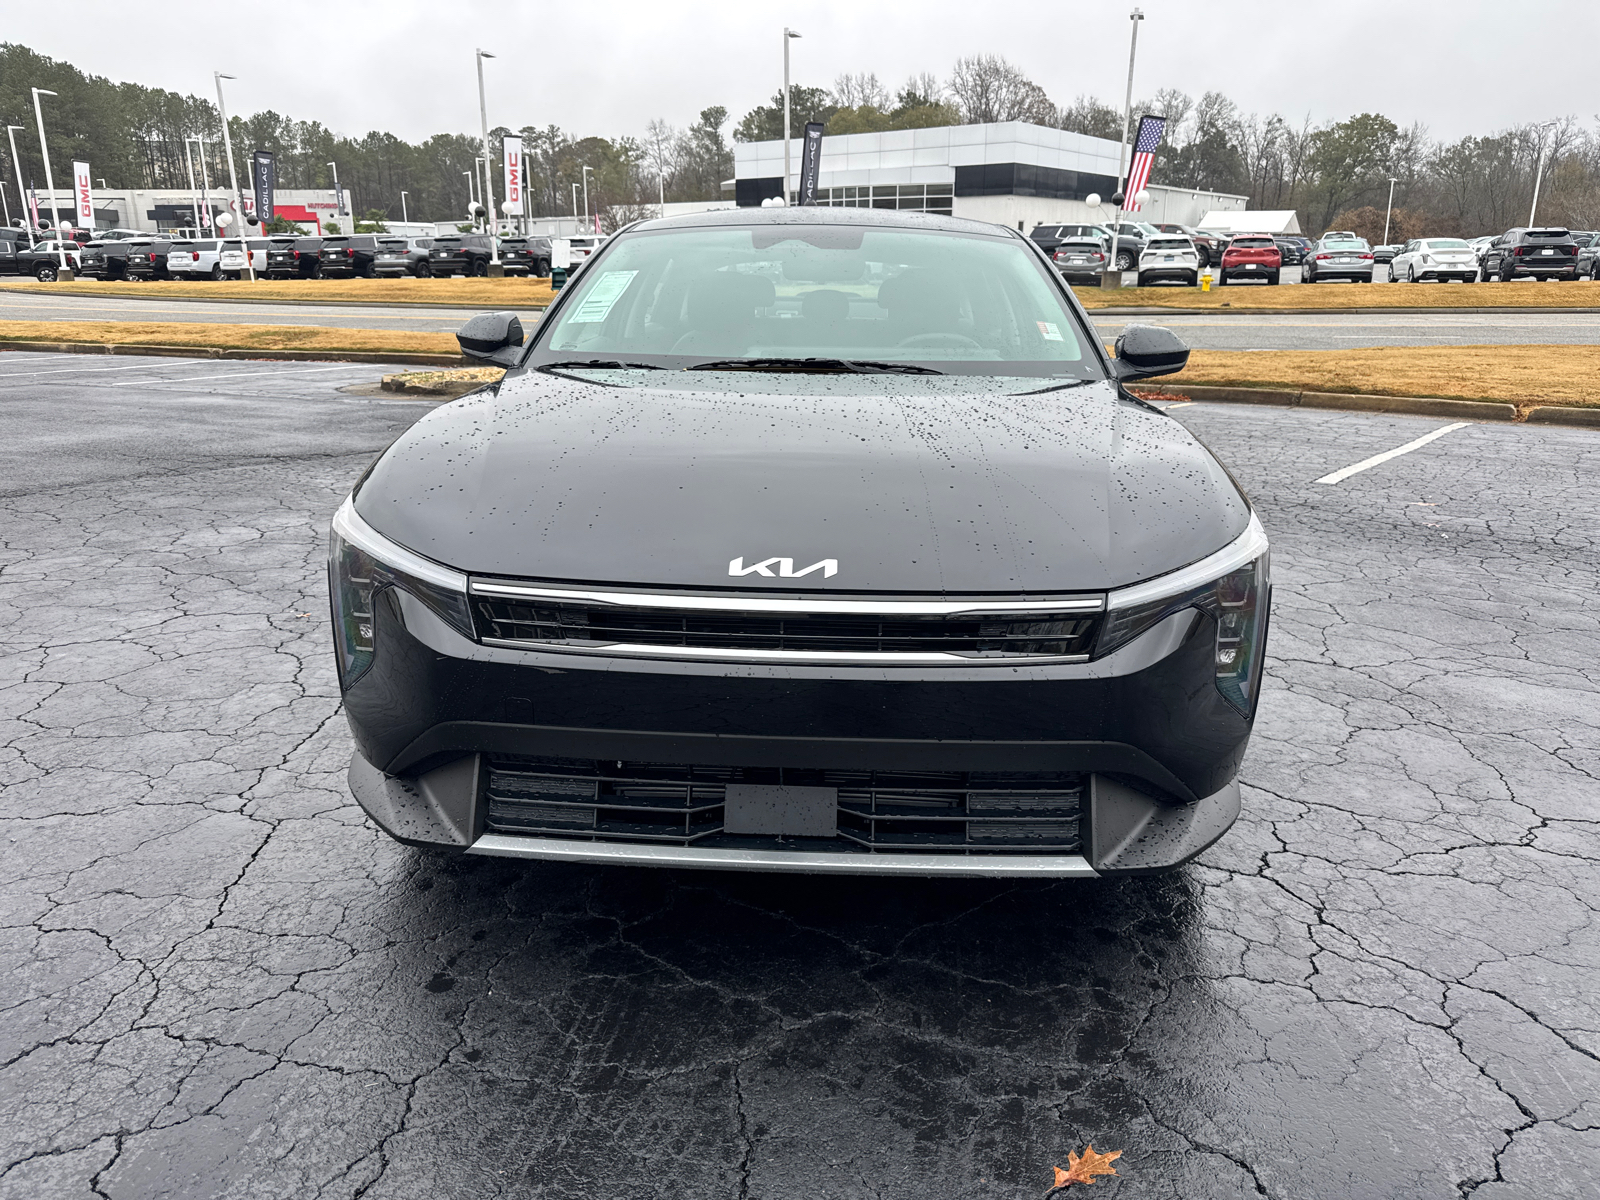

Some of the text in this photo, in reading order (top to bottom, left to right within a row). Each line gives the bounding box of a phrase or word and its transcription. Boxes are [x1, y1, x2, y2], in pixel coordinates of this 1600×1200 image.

[78, 174, 91, 217] GMC
[261, 167, 271, 219] CADILLAC
[508, 152, 519, 202] GMC
[806, 142, 817, 201] ADILLAC
[728, 556, 838, 579] KIA
